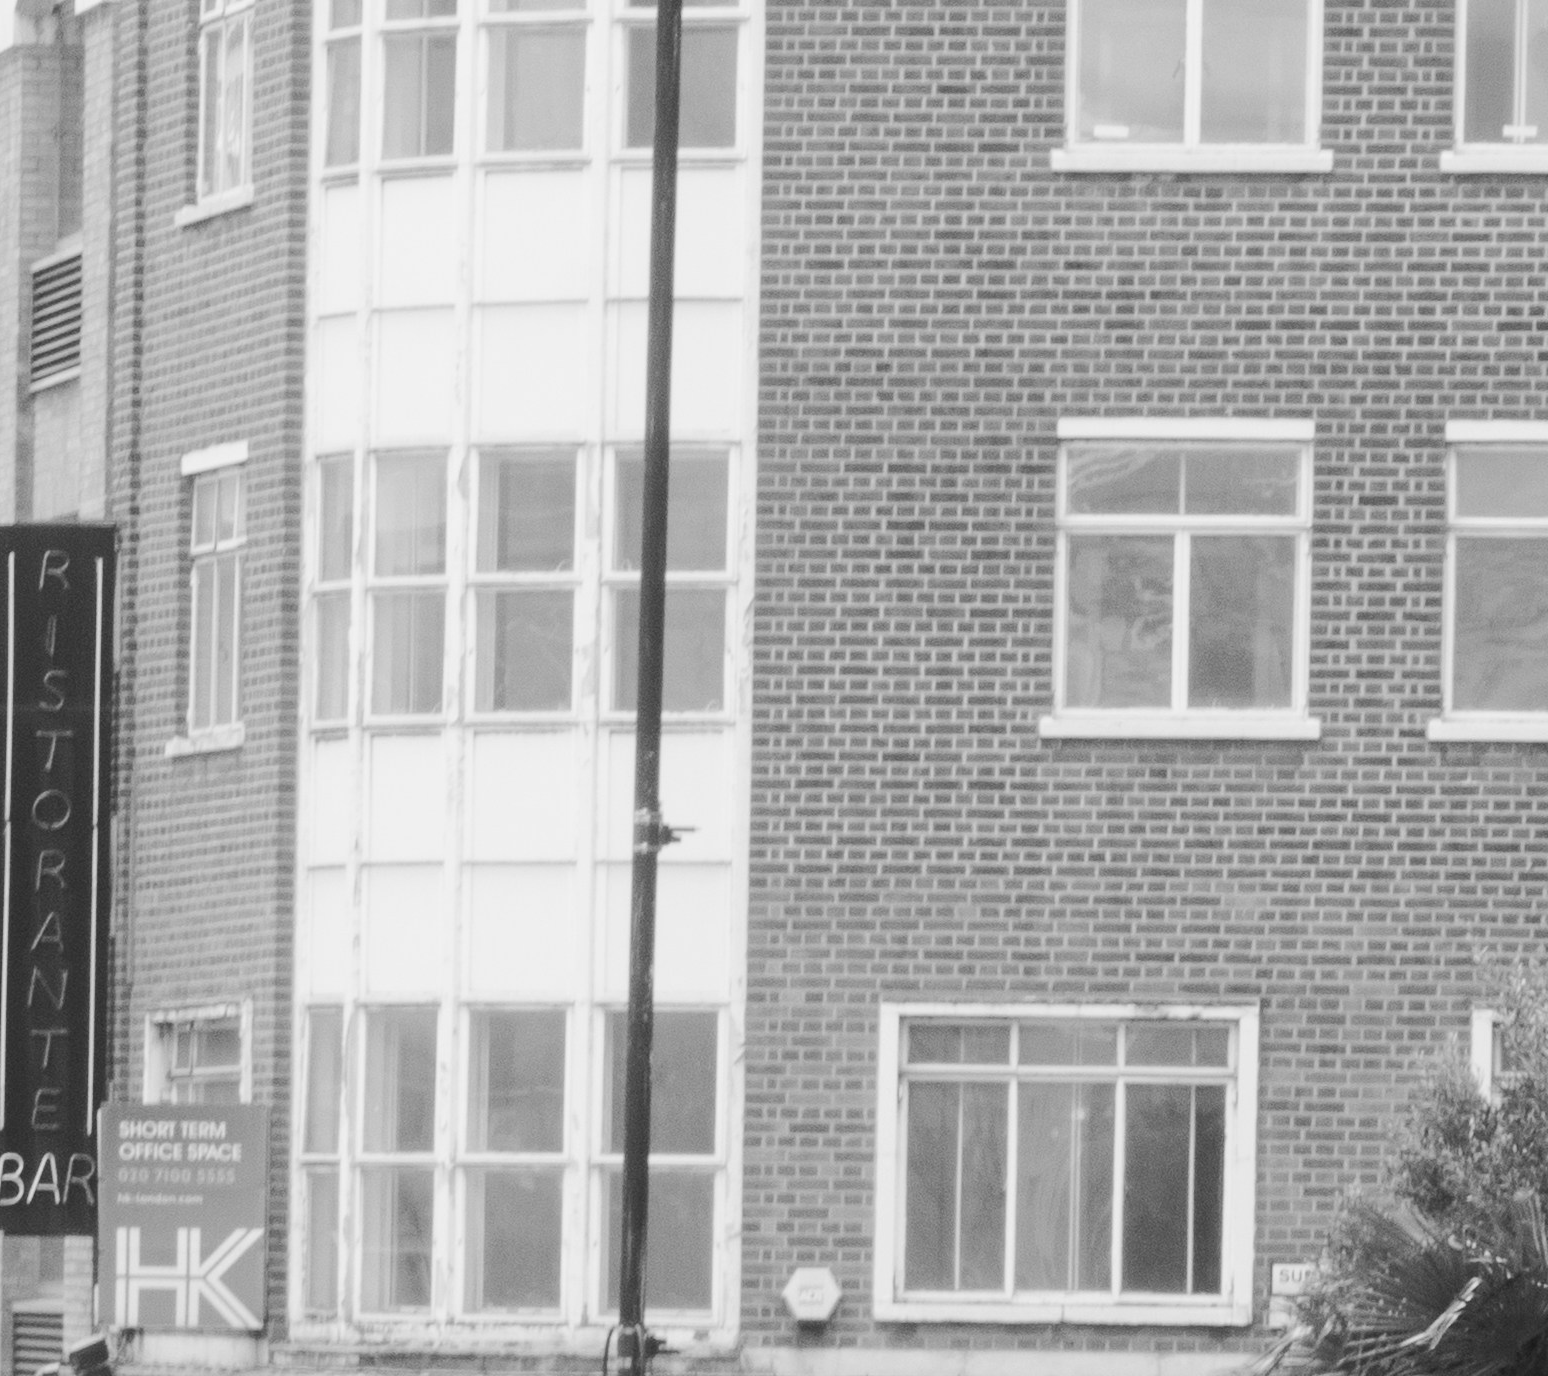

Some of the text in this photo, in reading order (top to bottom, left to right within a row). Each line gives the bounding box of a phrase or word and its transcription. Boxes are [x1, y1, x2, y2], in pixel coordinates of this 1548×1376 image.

[29, 550, 74, 1130] RISTORANTE
[118, 1120, 227, 1140] SHORT TERM
[118, 1141, 243, 1163] OFFICE SPACE
[114, 1225, 265, 1330] HK
